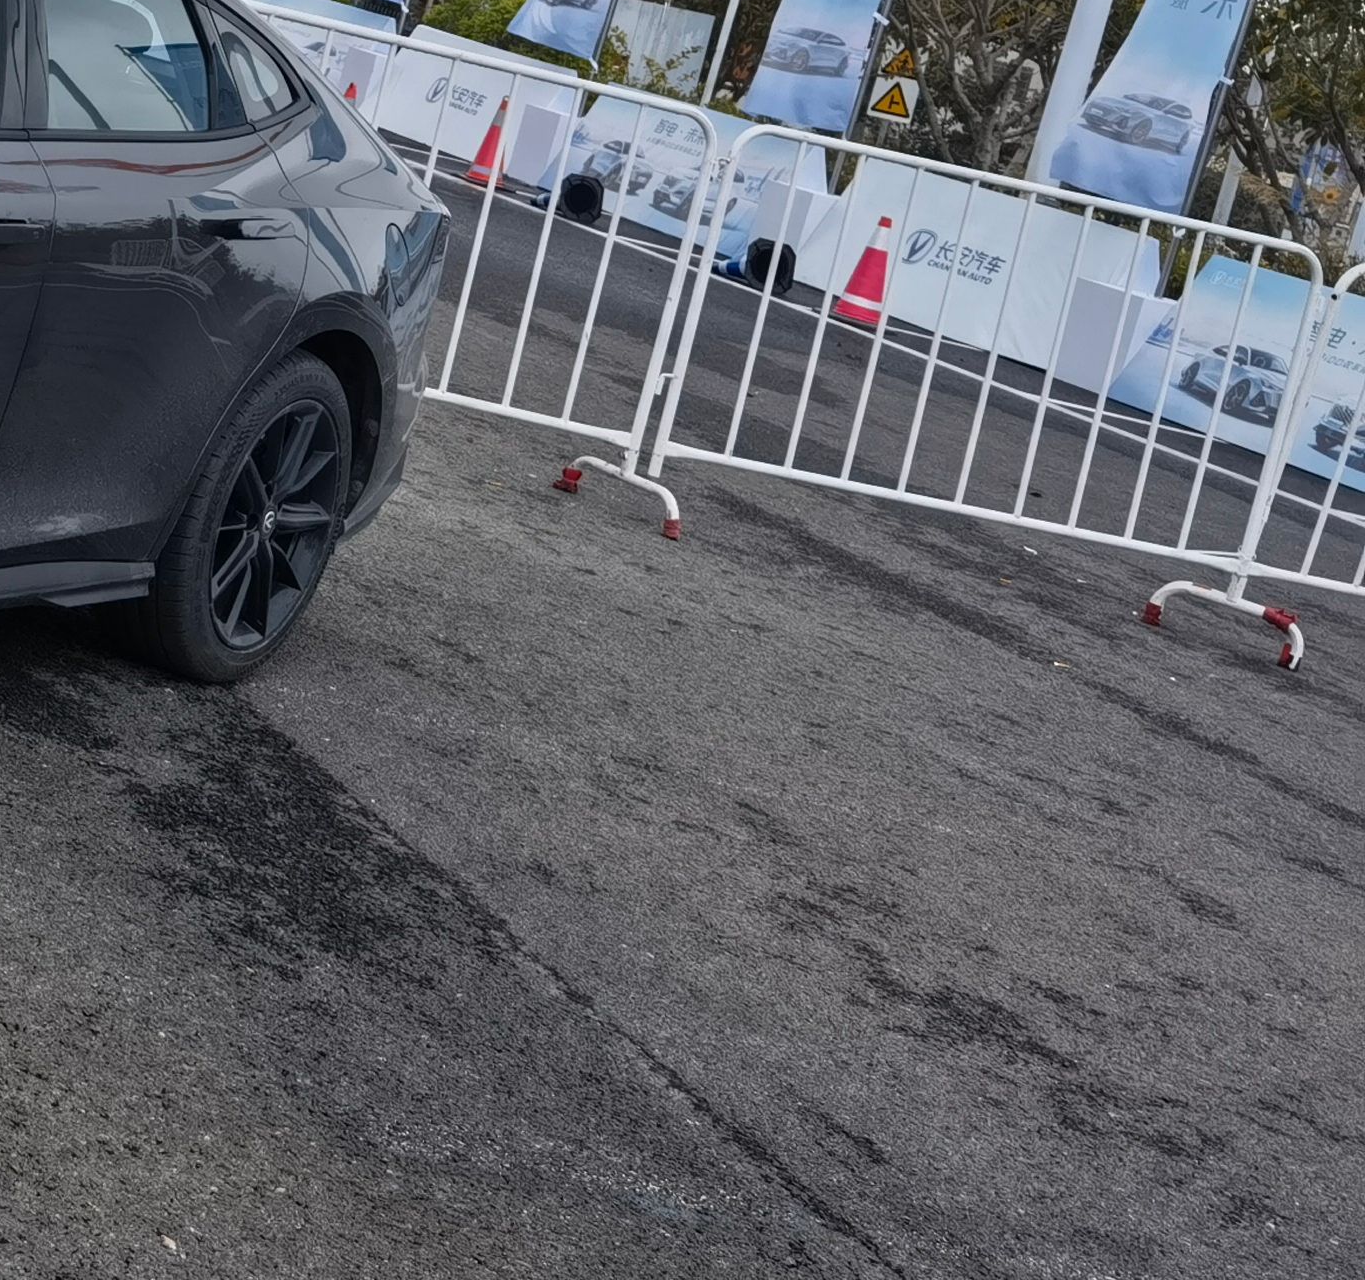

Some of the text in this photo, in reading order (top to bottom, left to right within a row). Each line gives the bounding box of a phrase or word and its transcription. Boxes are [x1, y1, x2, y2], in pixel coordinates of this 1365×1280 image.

[451, 84, 488, 108] 长安汽车
[935, 240, 1007, 275] 长安汽车
[927, 259, 993, 285] CHANAN AUTO
